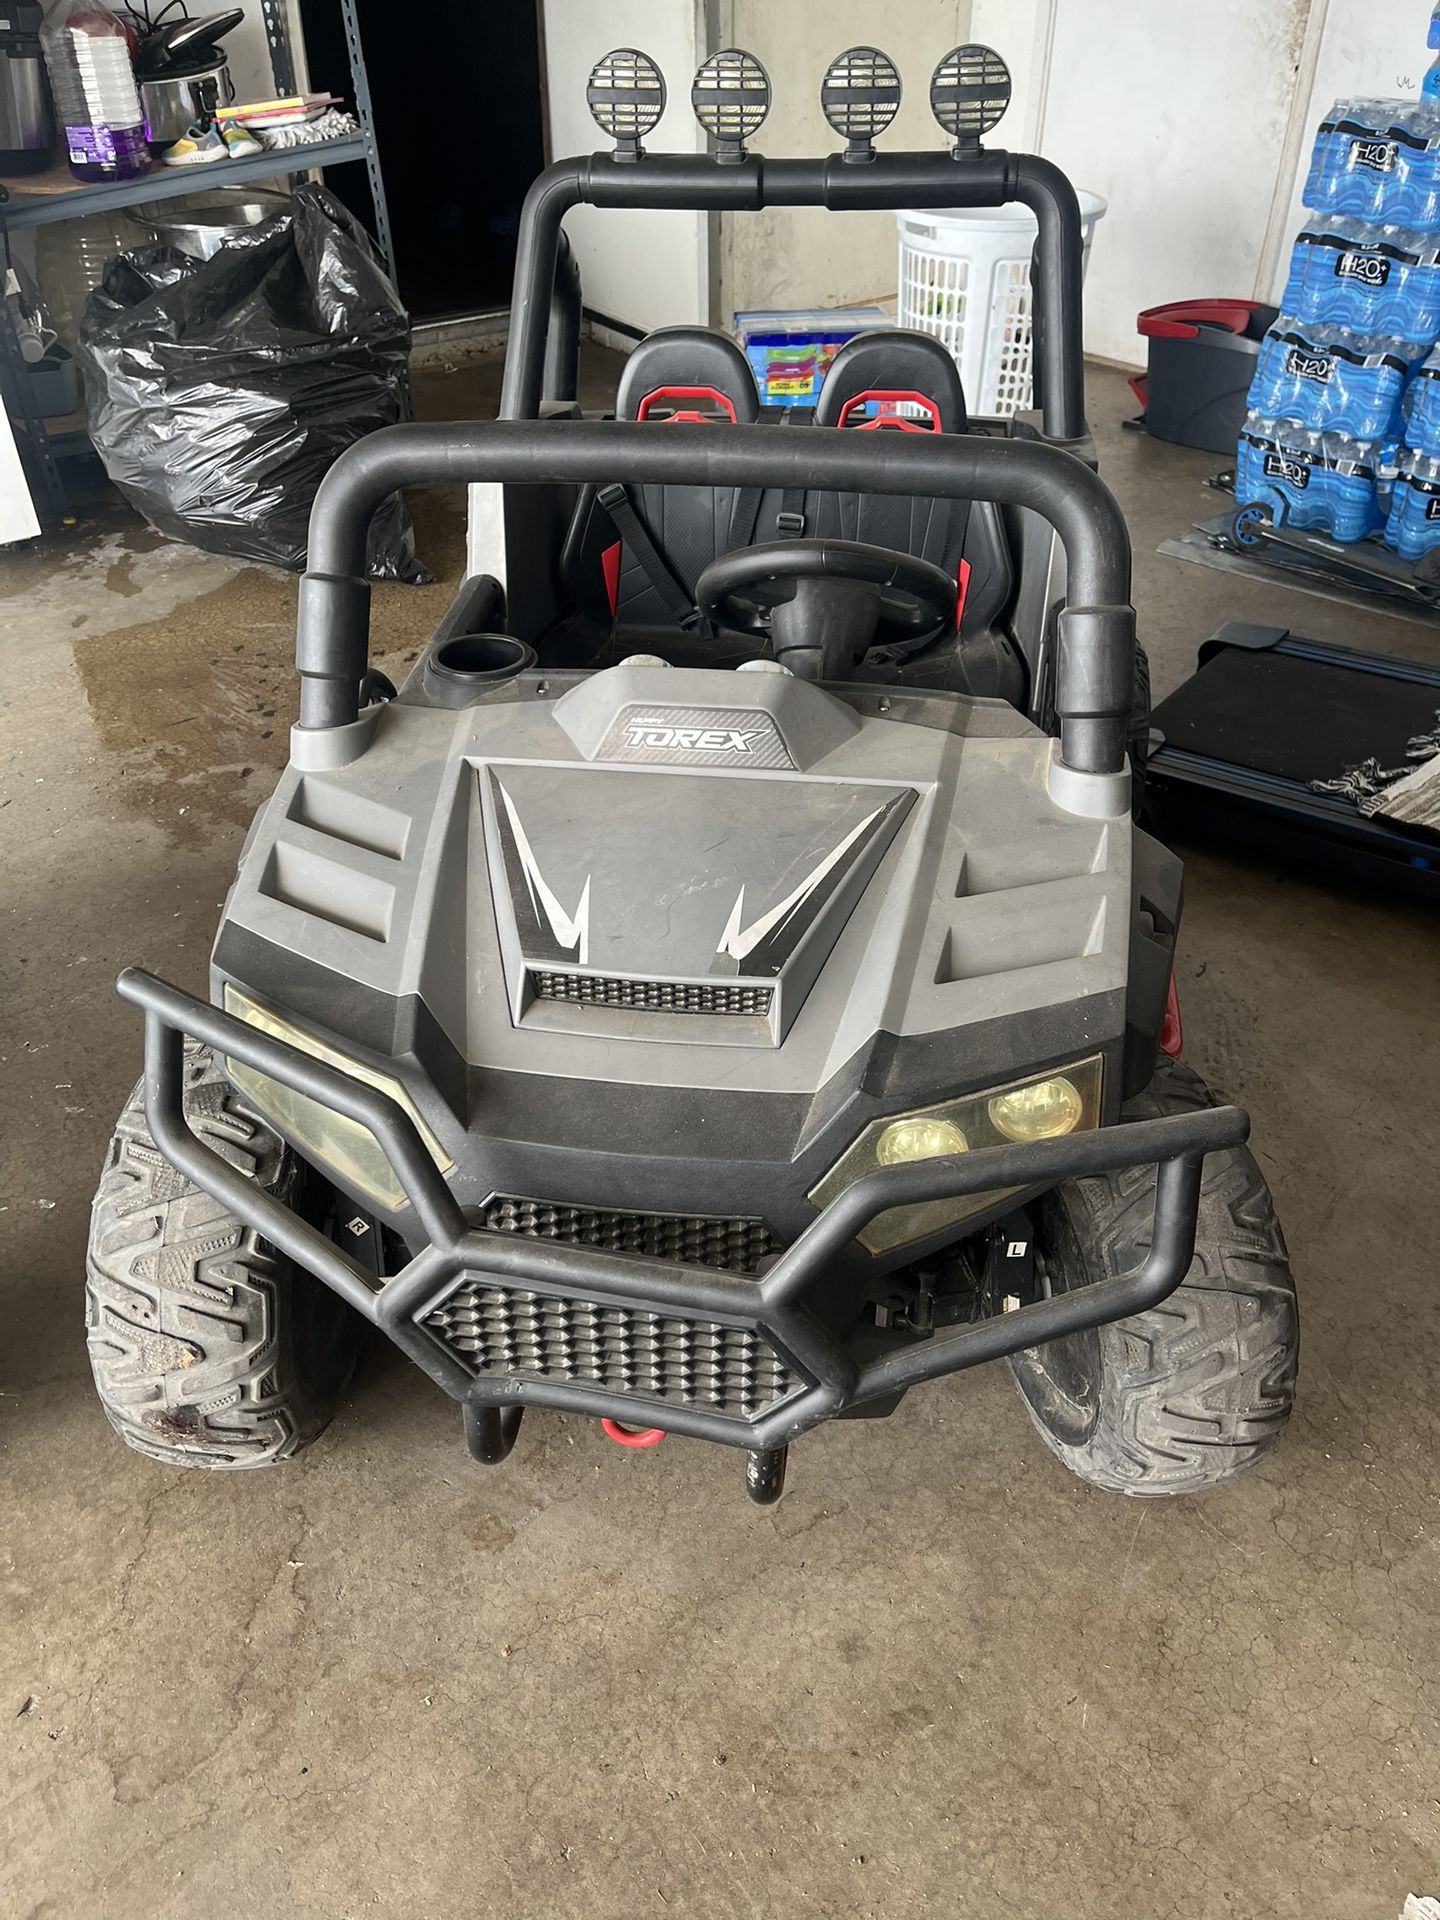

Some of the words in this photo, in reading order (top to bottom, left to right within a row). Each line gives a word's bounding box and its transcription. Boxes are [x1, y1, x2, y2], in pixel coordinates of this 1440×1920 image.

[623, 725, 771, 754] TOREX
[351, 1220, 365, 1232] R
[1012, 1244, 1022, 1256] L
